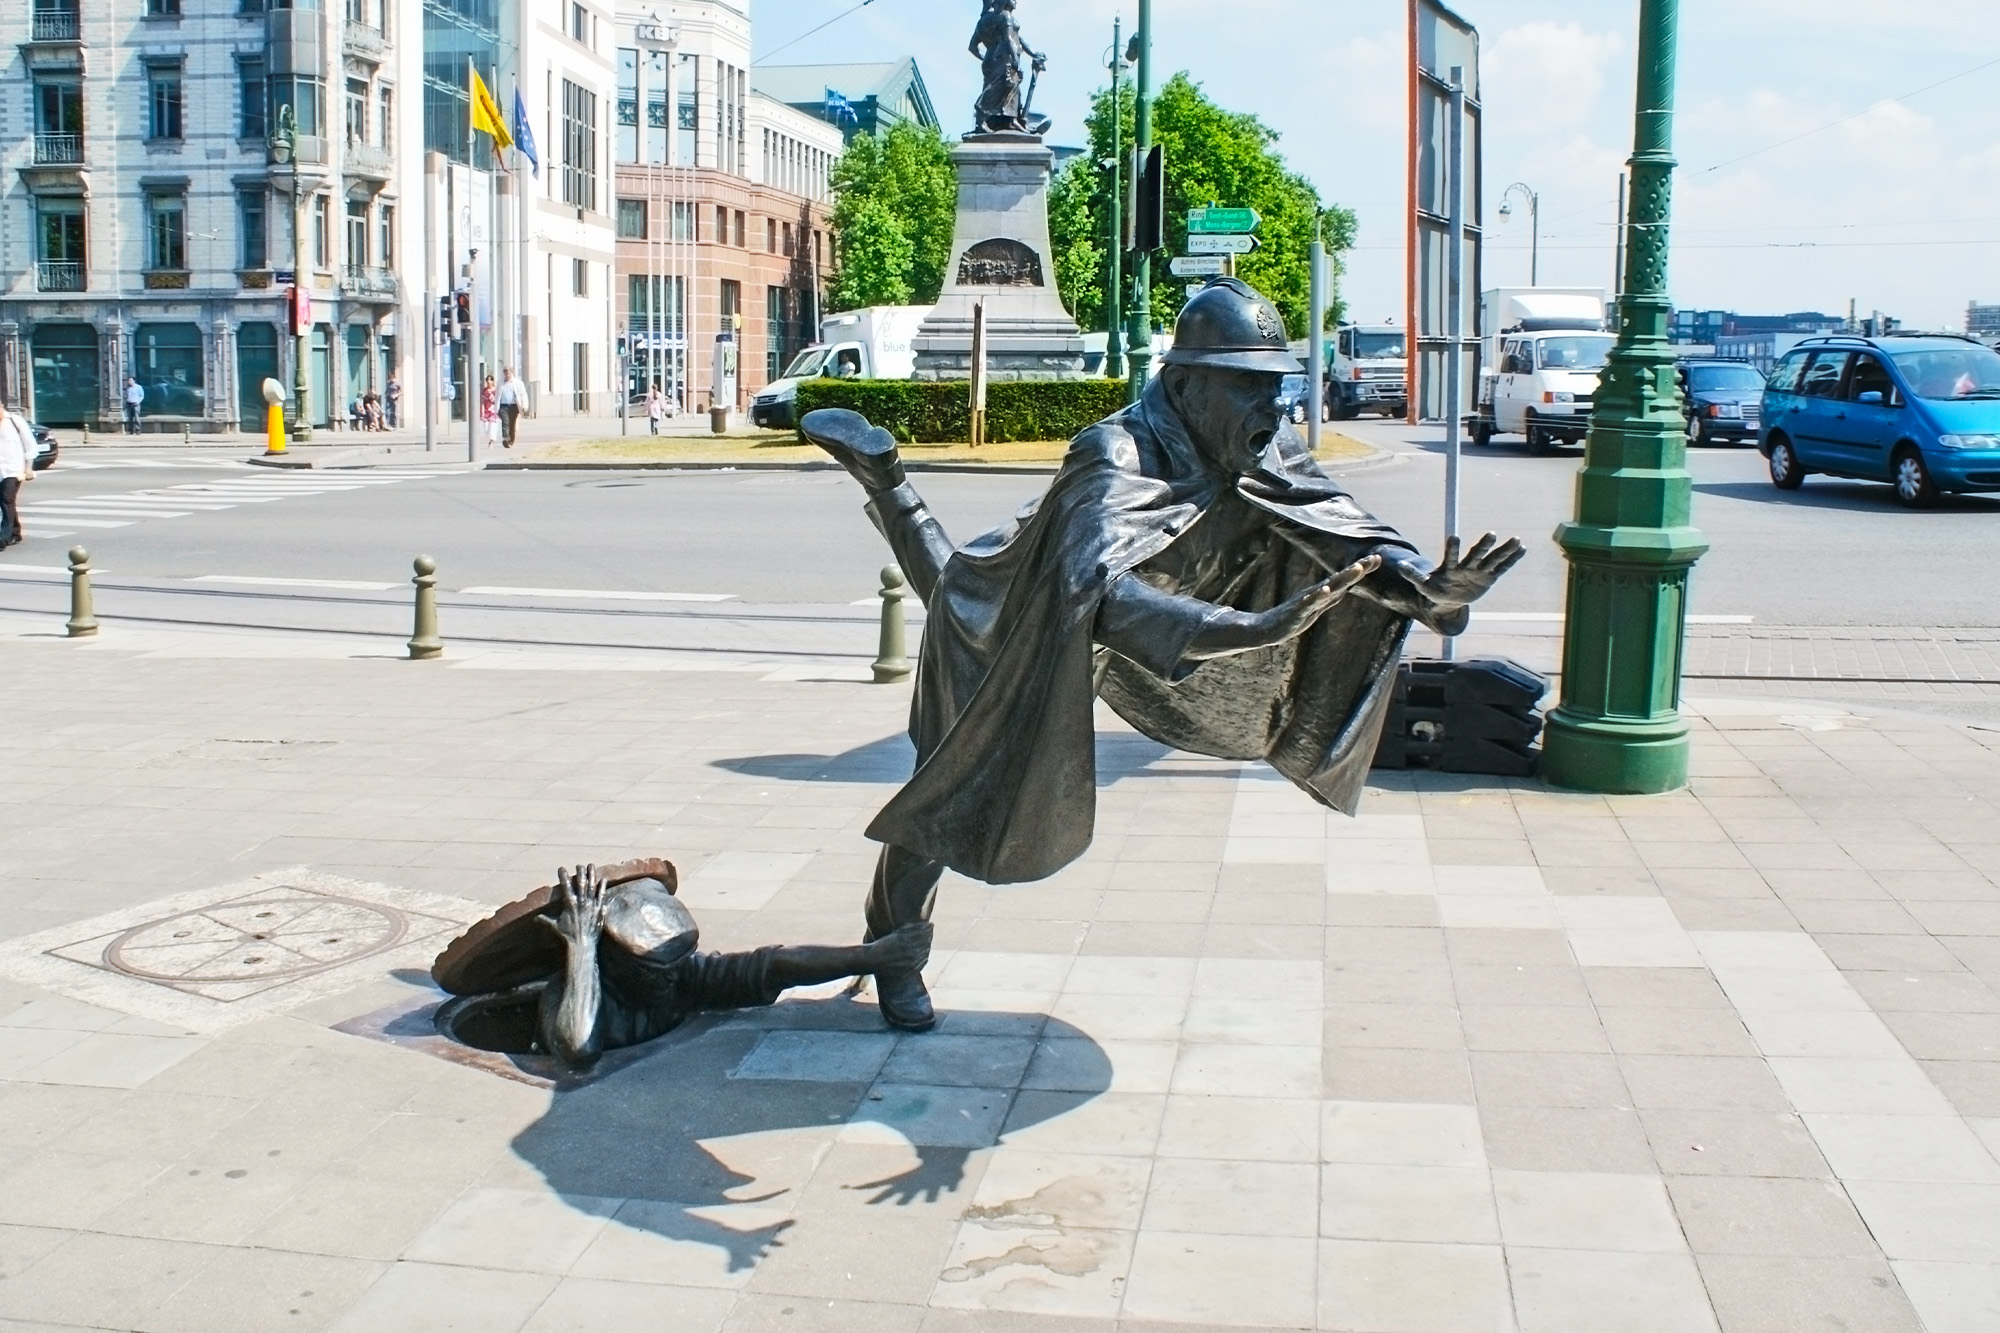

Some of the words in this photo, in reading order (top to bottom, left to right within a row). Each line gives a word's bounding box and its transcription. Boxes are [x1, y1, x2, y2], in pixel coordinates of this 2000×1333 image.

[639, 25, 680, 43] KBC
[1191, 210, 1205, 220] Ring
[883, 341, 906, 352] blue
